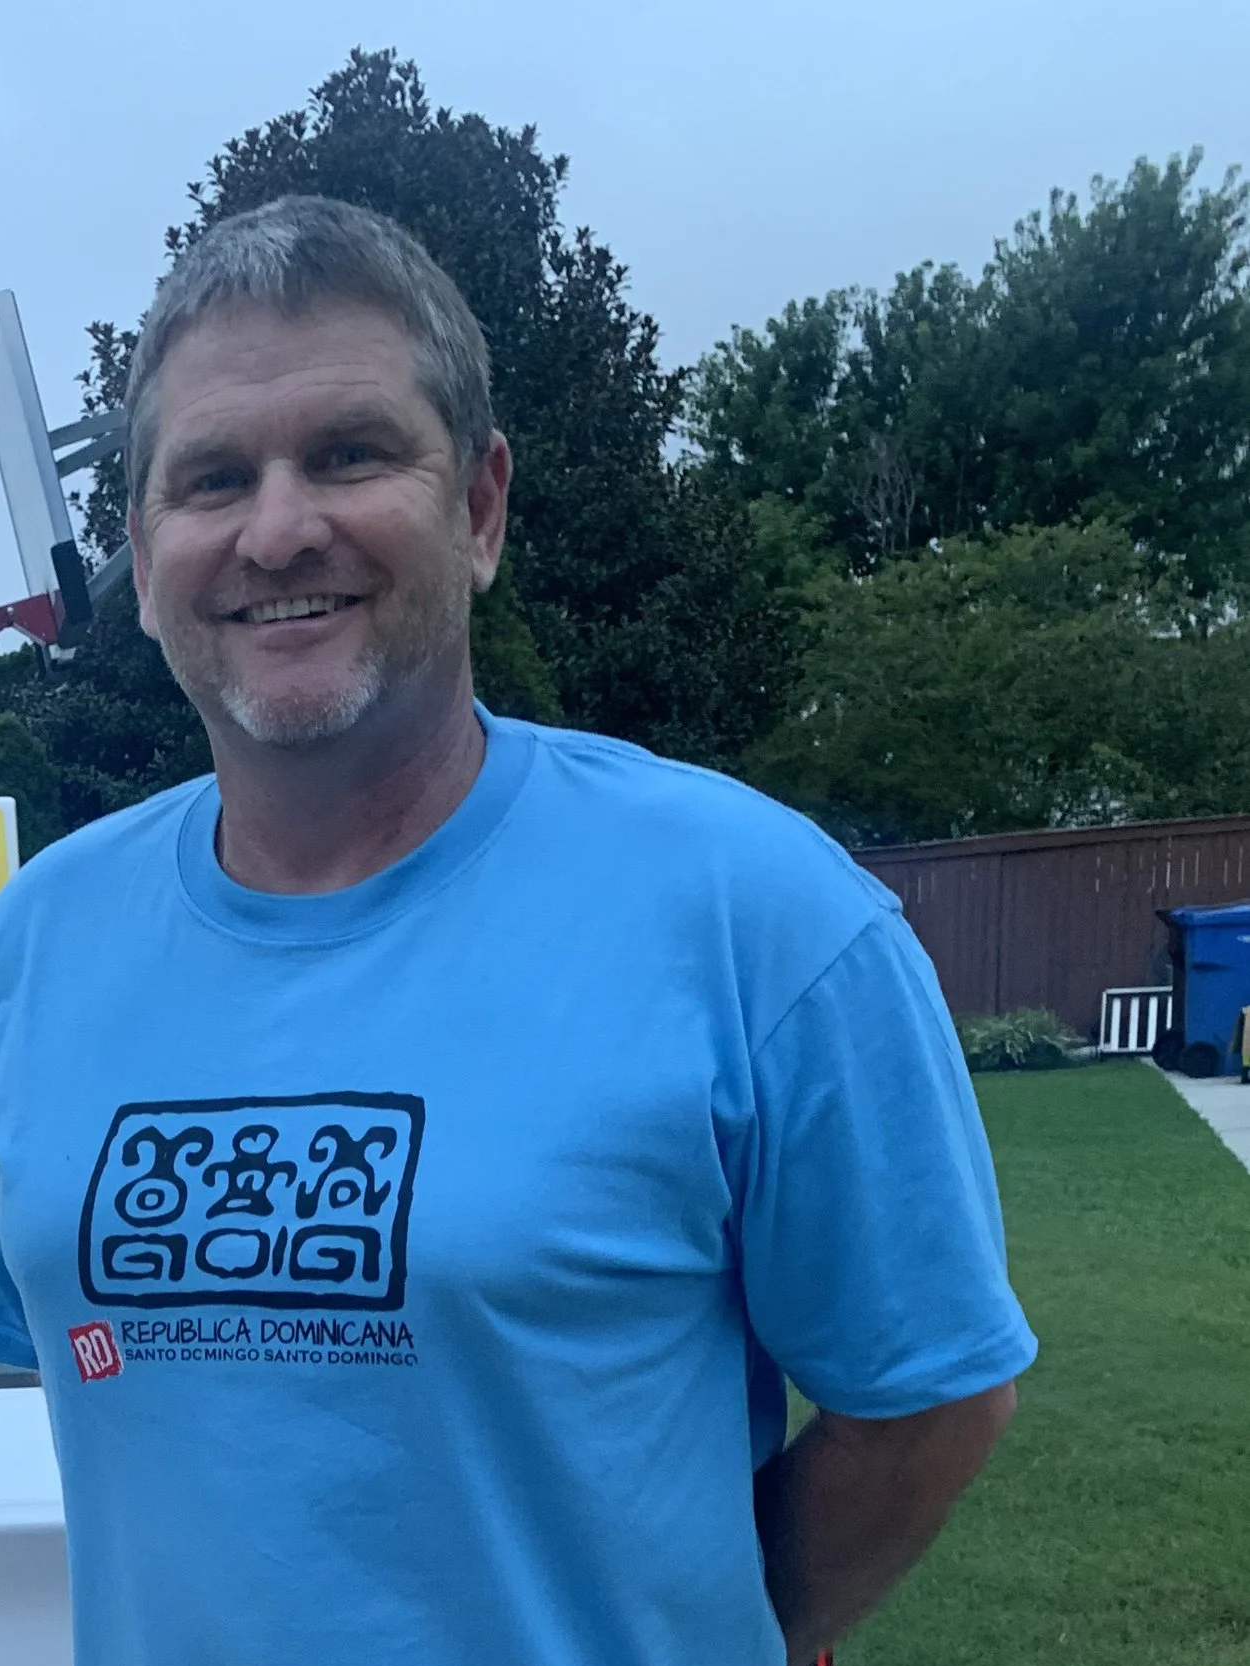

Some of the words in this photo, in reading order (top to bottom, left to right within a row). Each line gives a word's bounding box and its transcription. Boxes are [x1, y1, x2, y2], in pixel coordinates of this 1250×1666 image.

[121, 1317, 250, 1344] REPUBLICA
[261, 1318, 414, 1349] DOMINICANA
[125, 1348, 176, 1361] SANTO
[264, 1348, 322, 1364] SANTO
[328, 1351, 418, 1367] DOMINGO
